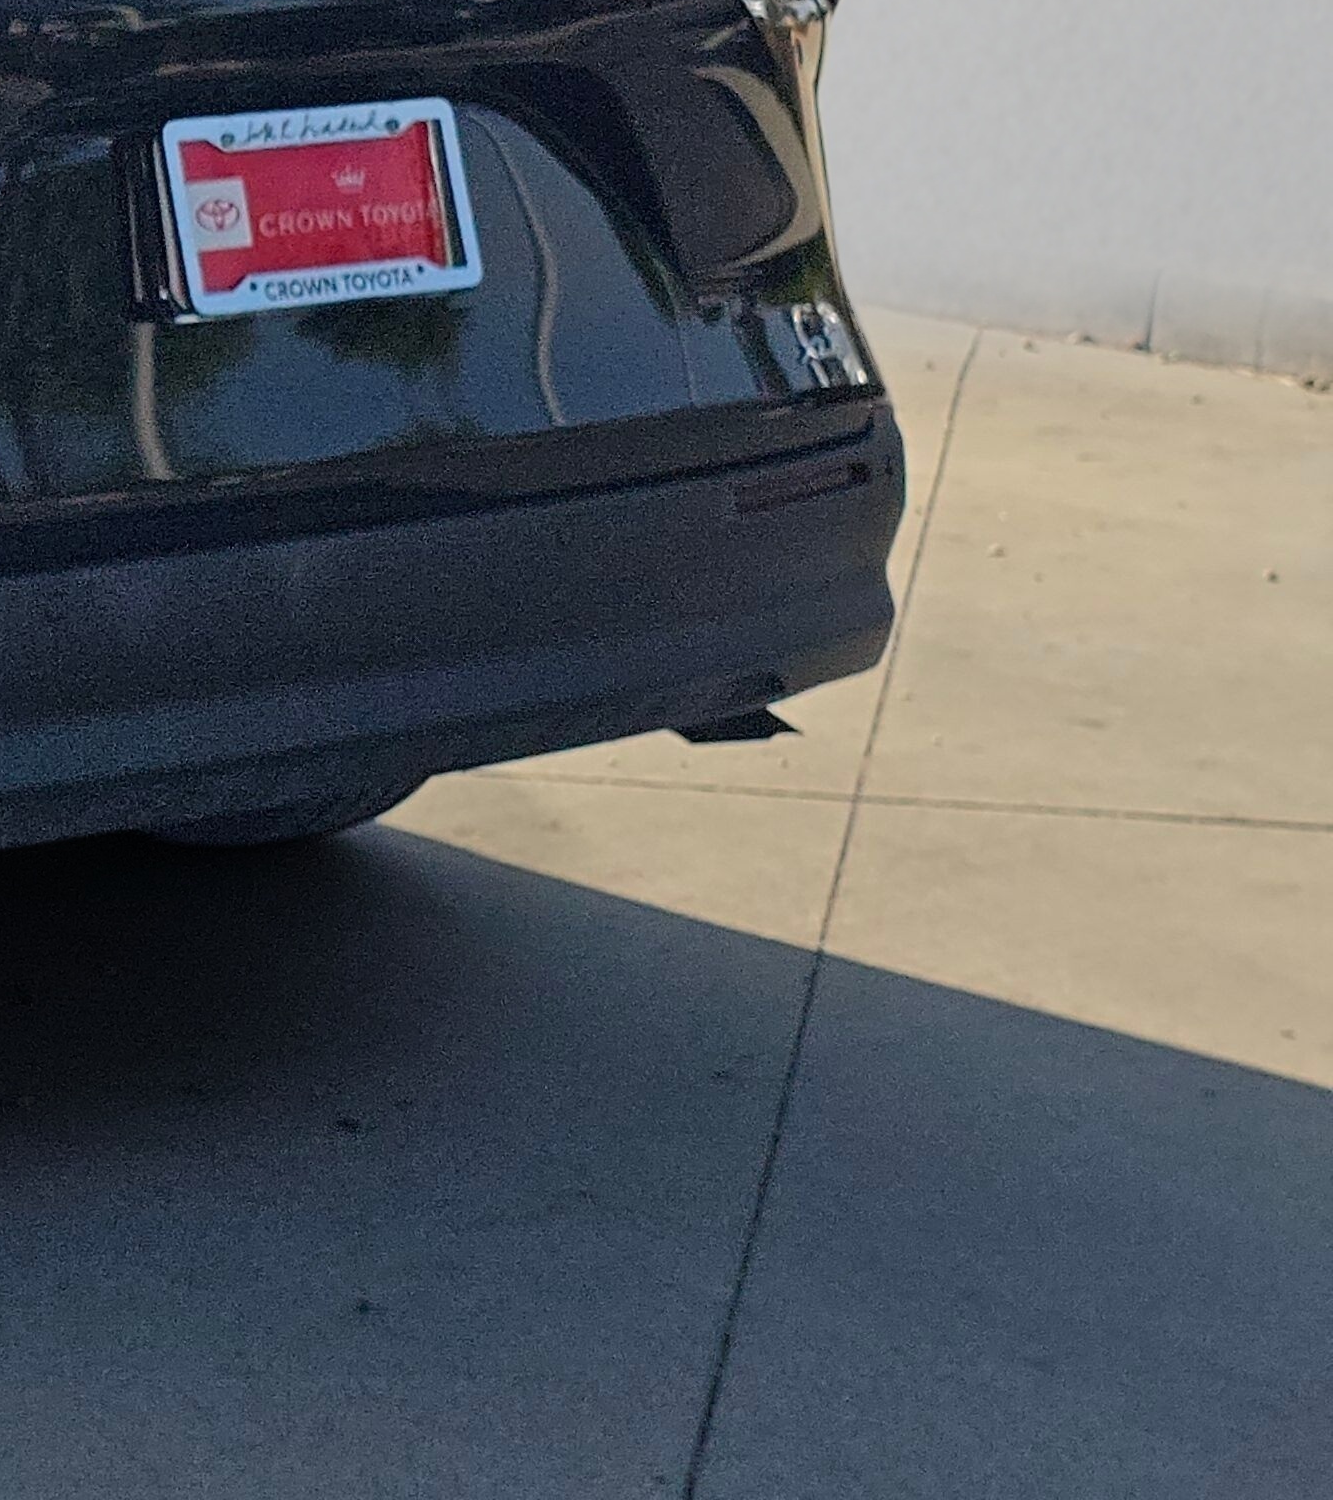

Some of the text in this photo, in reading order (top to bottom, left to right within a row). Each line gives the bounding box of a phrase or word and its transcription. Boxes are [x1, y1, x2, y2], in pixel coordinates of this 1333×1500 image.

[258, 209, 351, 238] CROWN
[264, 268, 413, 300] CROWN TOYOTA
